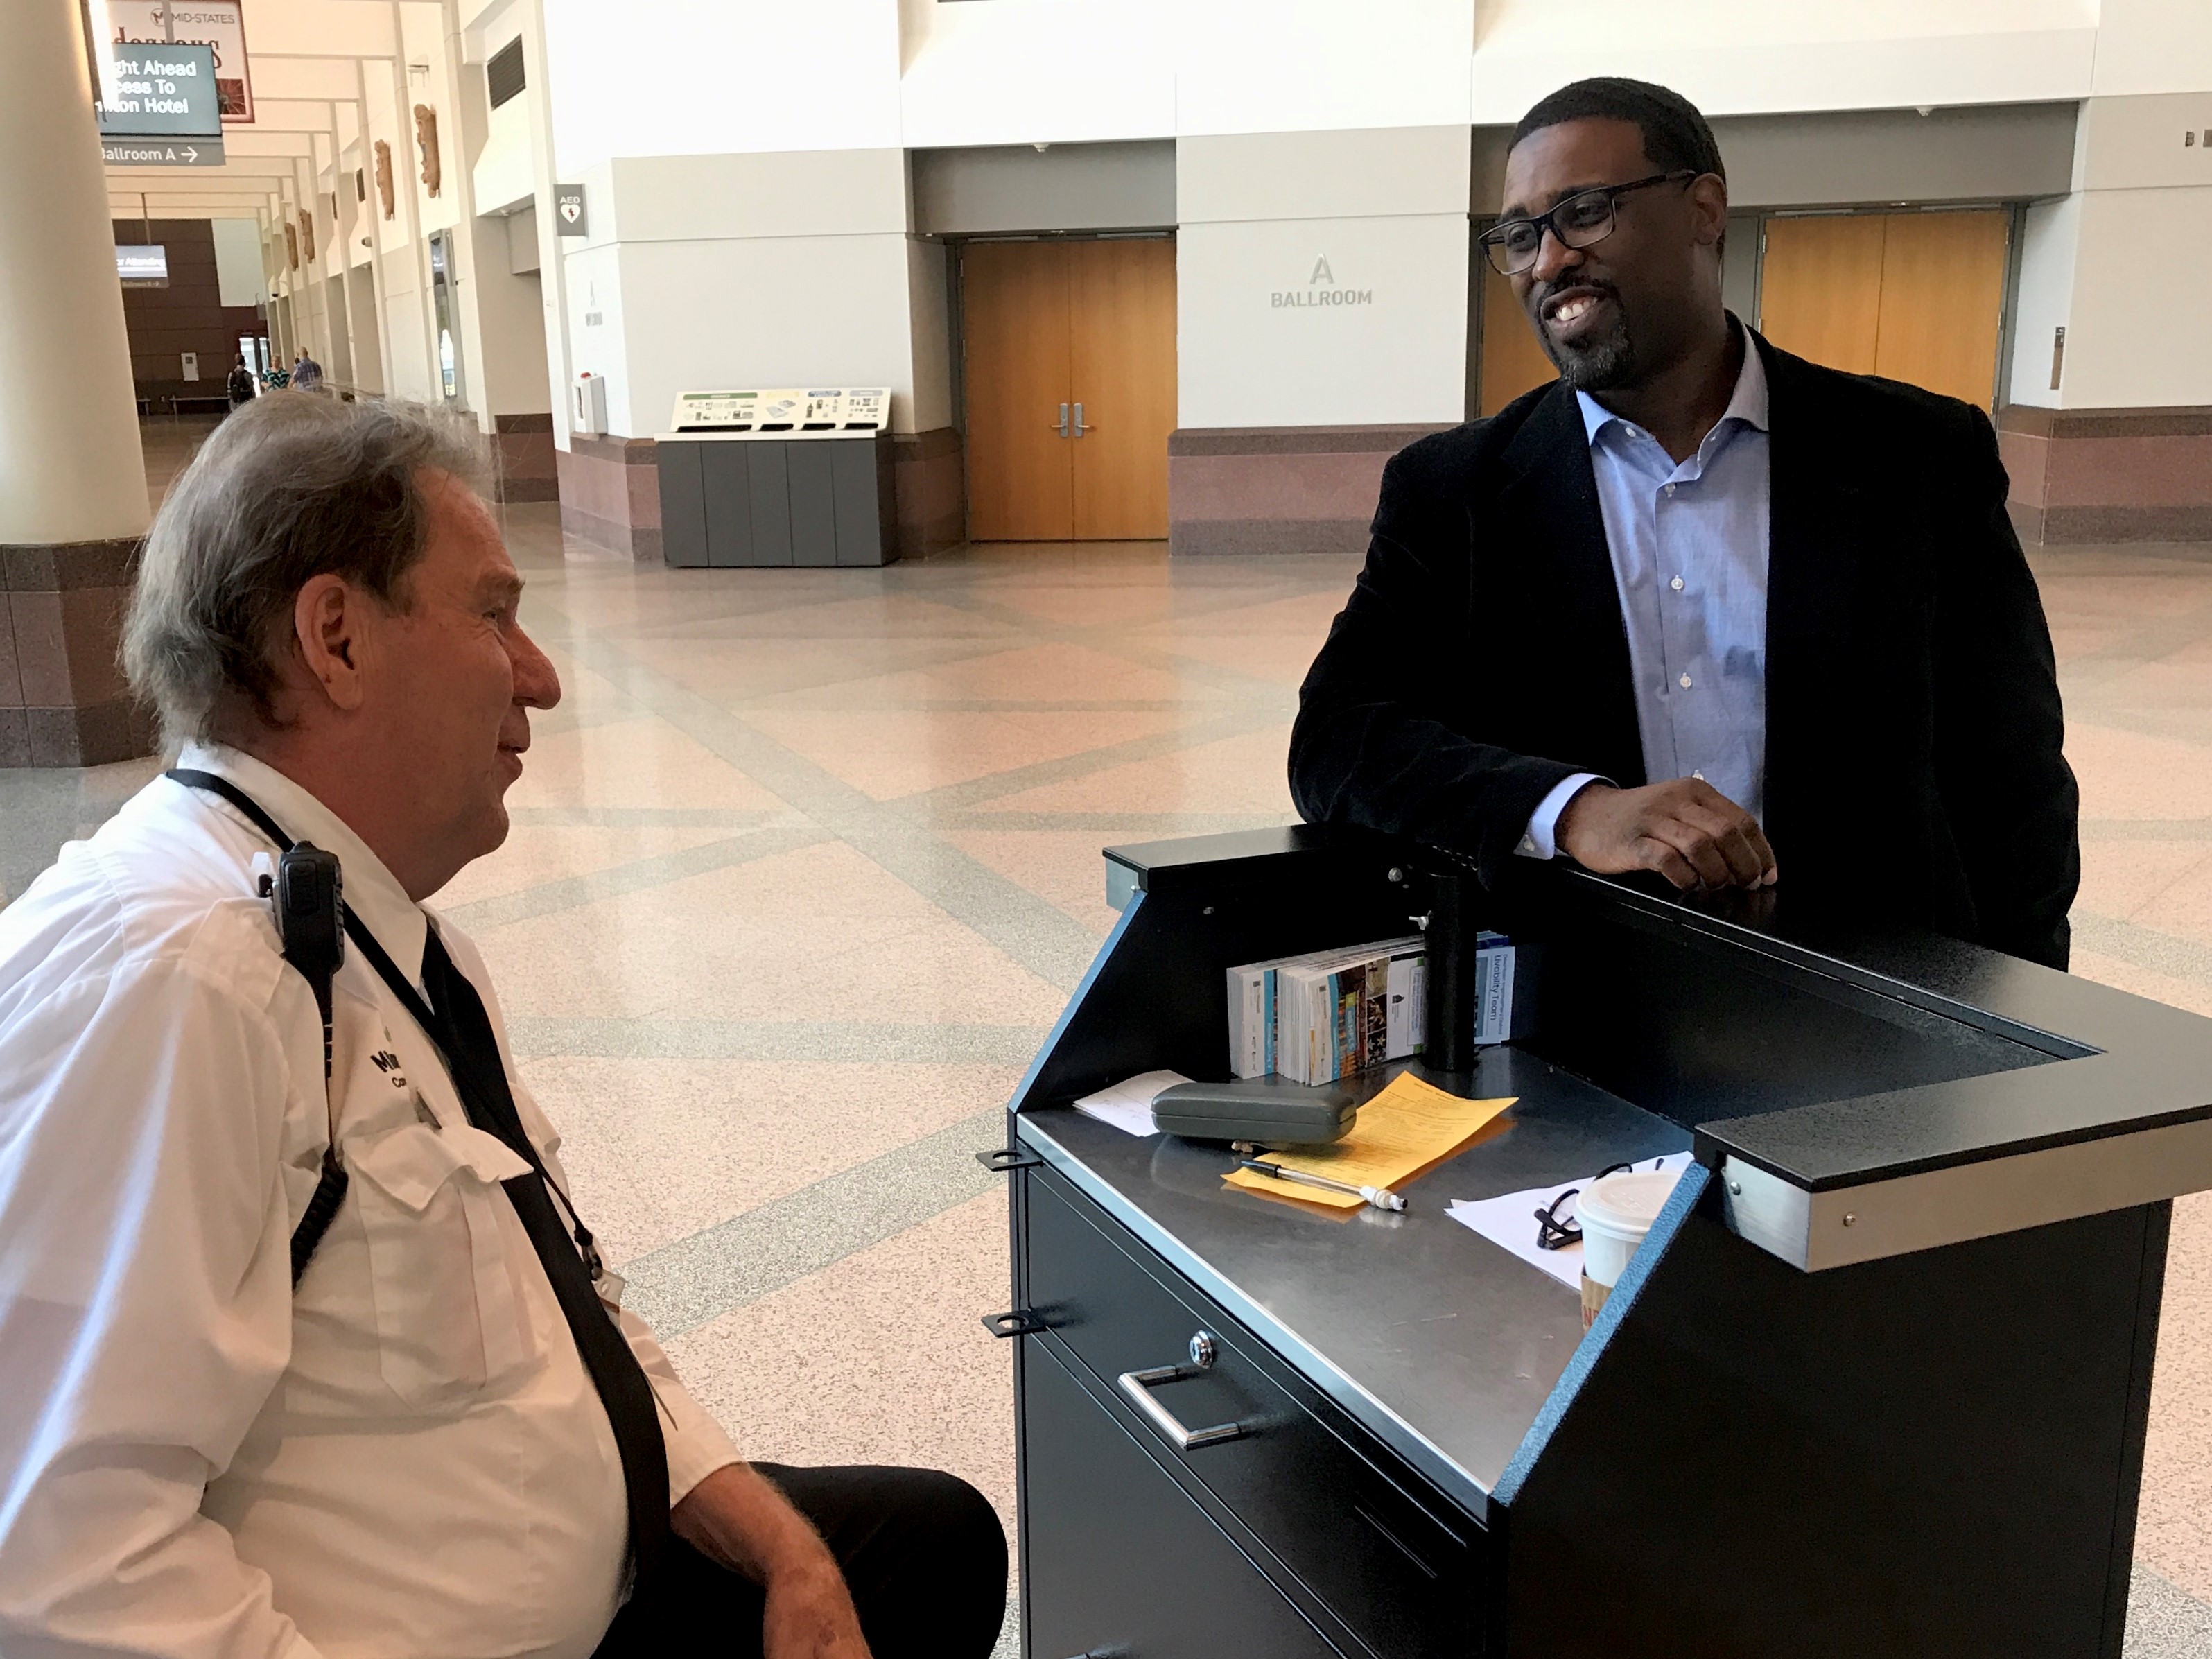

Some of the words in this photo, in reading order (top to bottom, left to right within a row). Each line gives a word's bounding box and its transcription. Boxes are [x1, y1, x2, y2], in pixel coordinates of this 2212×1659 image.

[172, 12, 235, 24] MID-STATES
[143, 60, 197, 77] Ahead
[155, 78, 176, 95] To
[144, 98, 189, 114] Hotel
[166, 148, 176, 160] A
[559, 196, 581, 205] AED
[1309, 253, 1334, 284] A
[1271, 289, 1372, 308] BALLROOM
[1490, 955, 1501, 993] Livability
[1490, 996, 1499, 1020] Team
